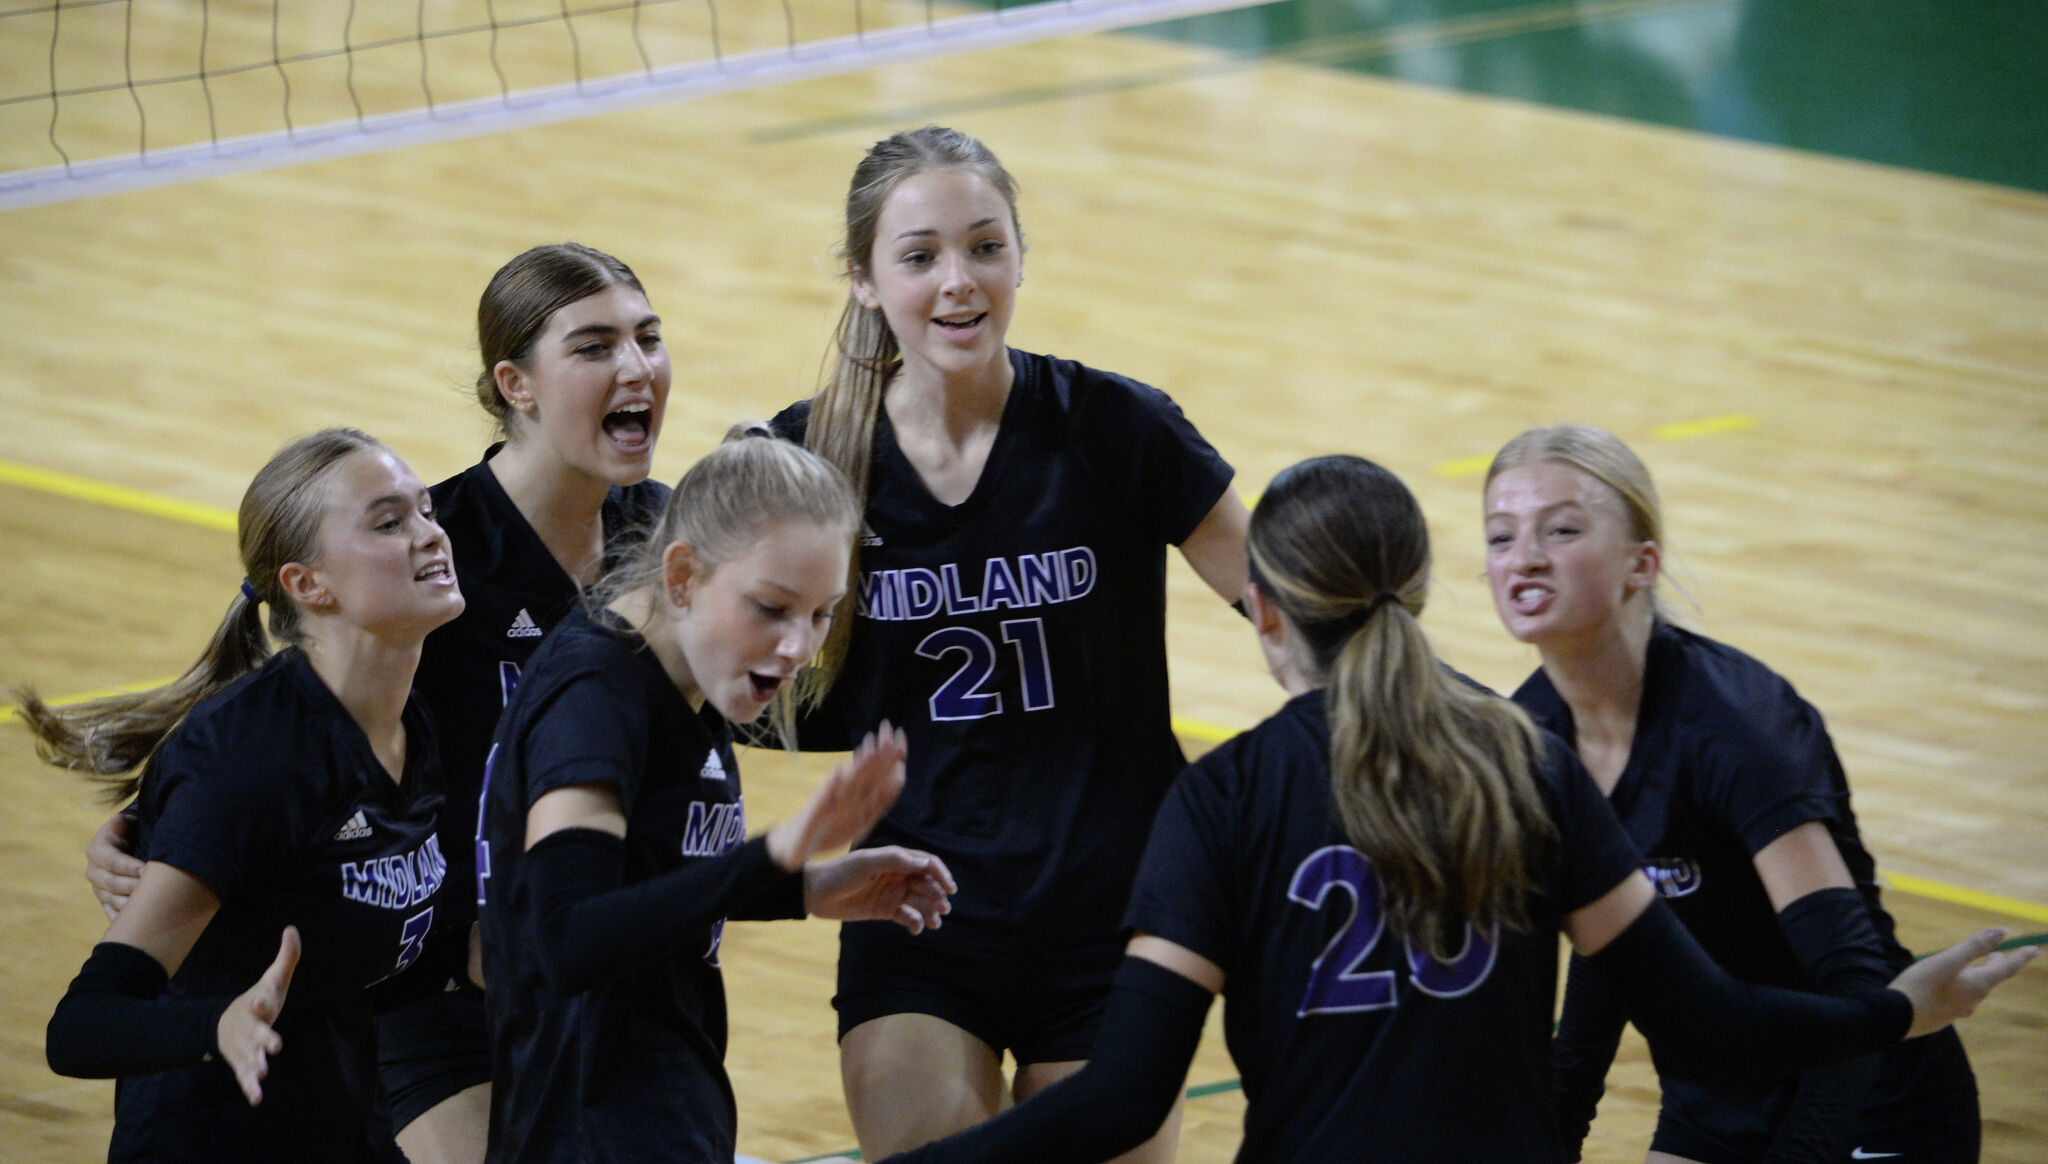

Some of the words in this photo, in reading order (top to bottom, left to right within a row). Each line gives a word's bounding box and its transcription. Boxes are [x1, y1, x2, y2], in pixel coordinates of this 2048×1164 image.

[857, 546, 1097, 621] MIDLAND
[914, 617, 1055, 721] 21
[334, 827, 373, 841] adidas
[682, 796, 746, 857] MID
[1287, 844, 1498, 1018] 20
